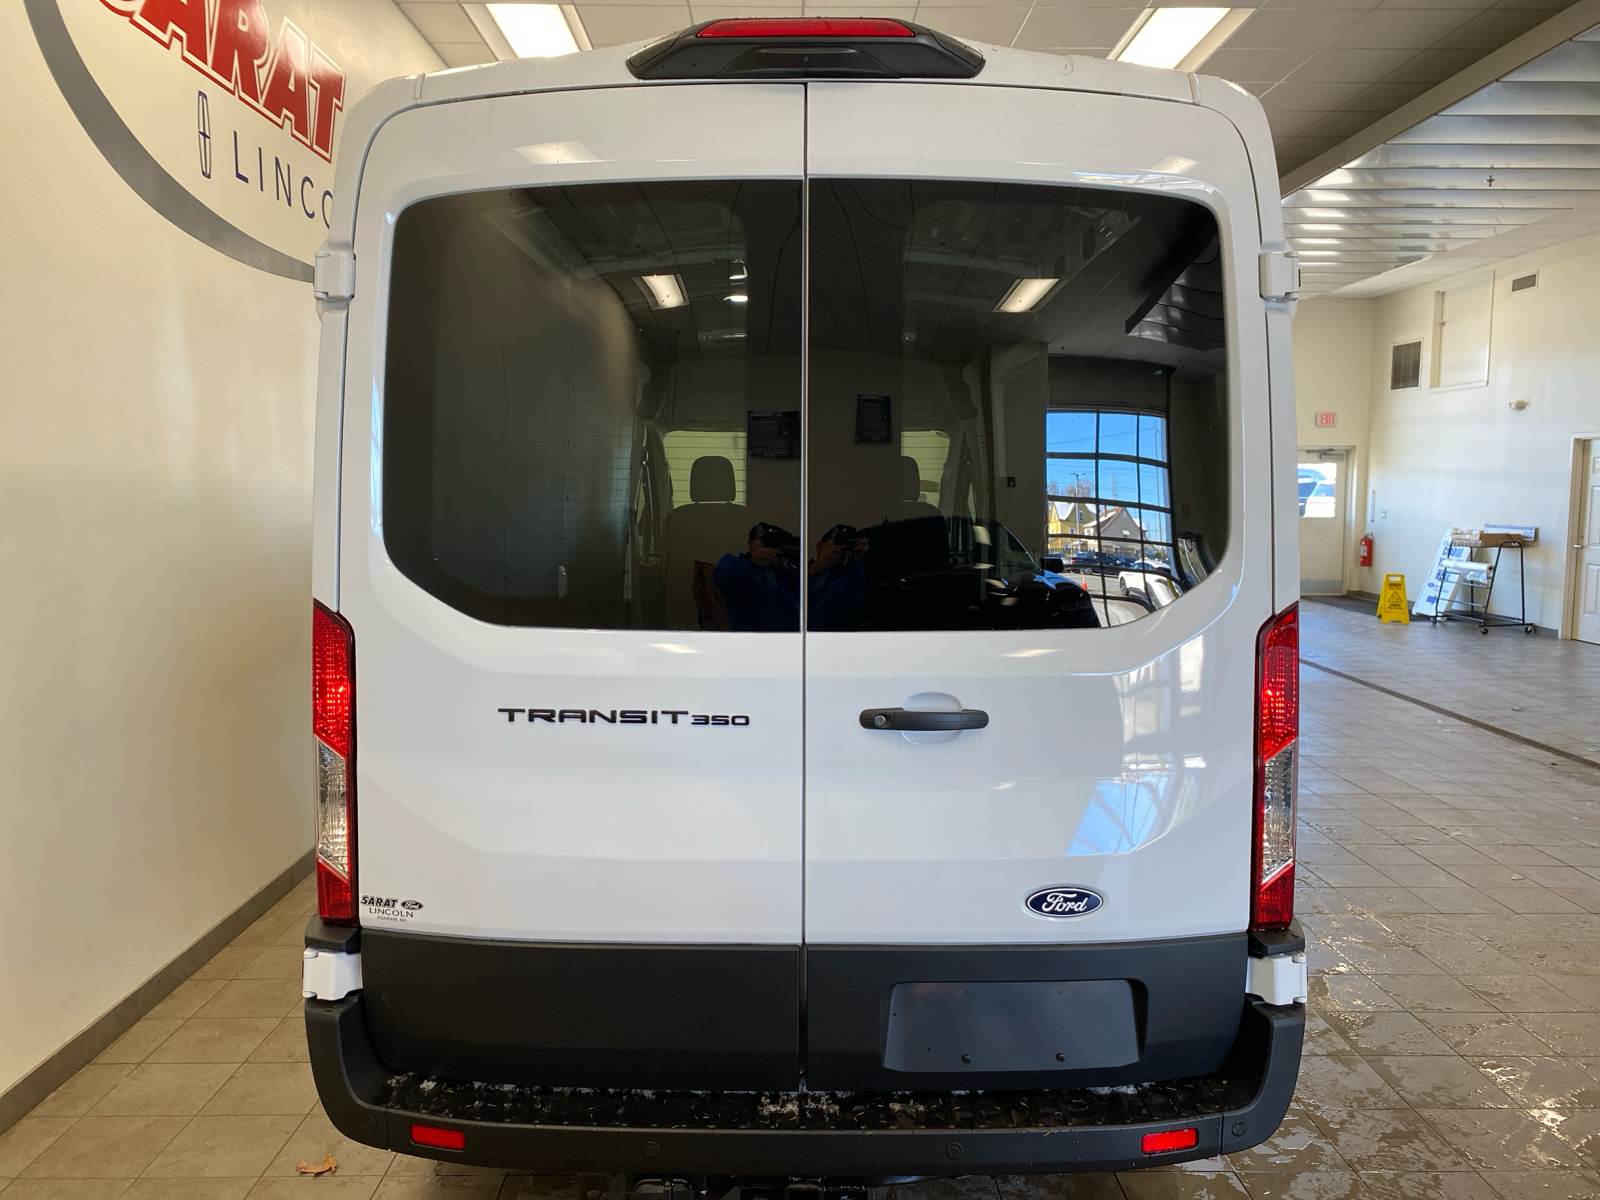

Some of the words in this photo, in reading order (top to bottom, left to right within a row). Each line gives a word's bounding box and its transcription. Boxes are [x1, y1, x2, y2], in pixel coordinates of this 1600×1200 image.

[99, 0, 346, 164] ARAT
[1320, 412, 1336, 426] EXIT
[498, 708, 689, 724] TRANSIT
[691, 714, 750, 726] 350
[361, 895, 399, 908] SARAT
[1041, 892, 1089, 912] Ford
[369, 907, 414, 918] LINCOLN
